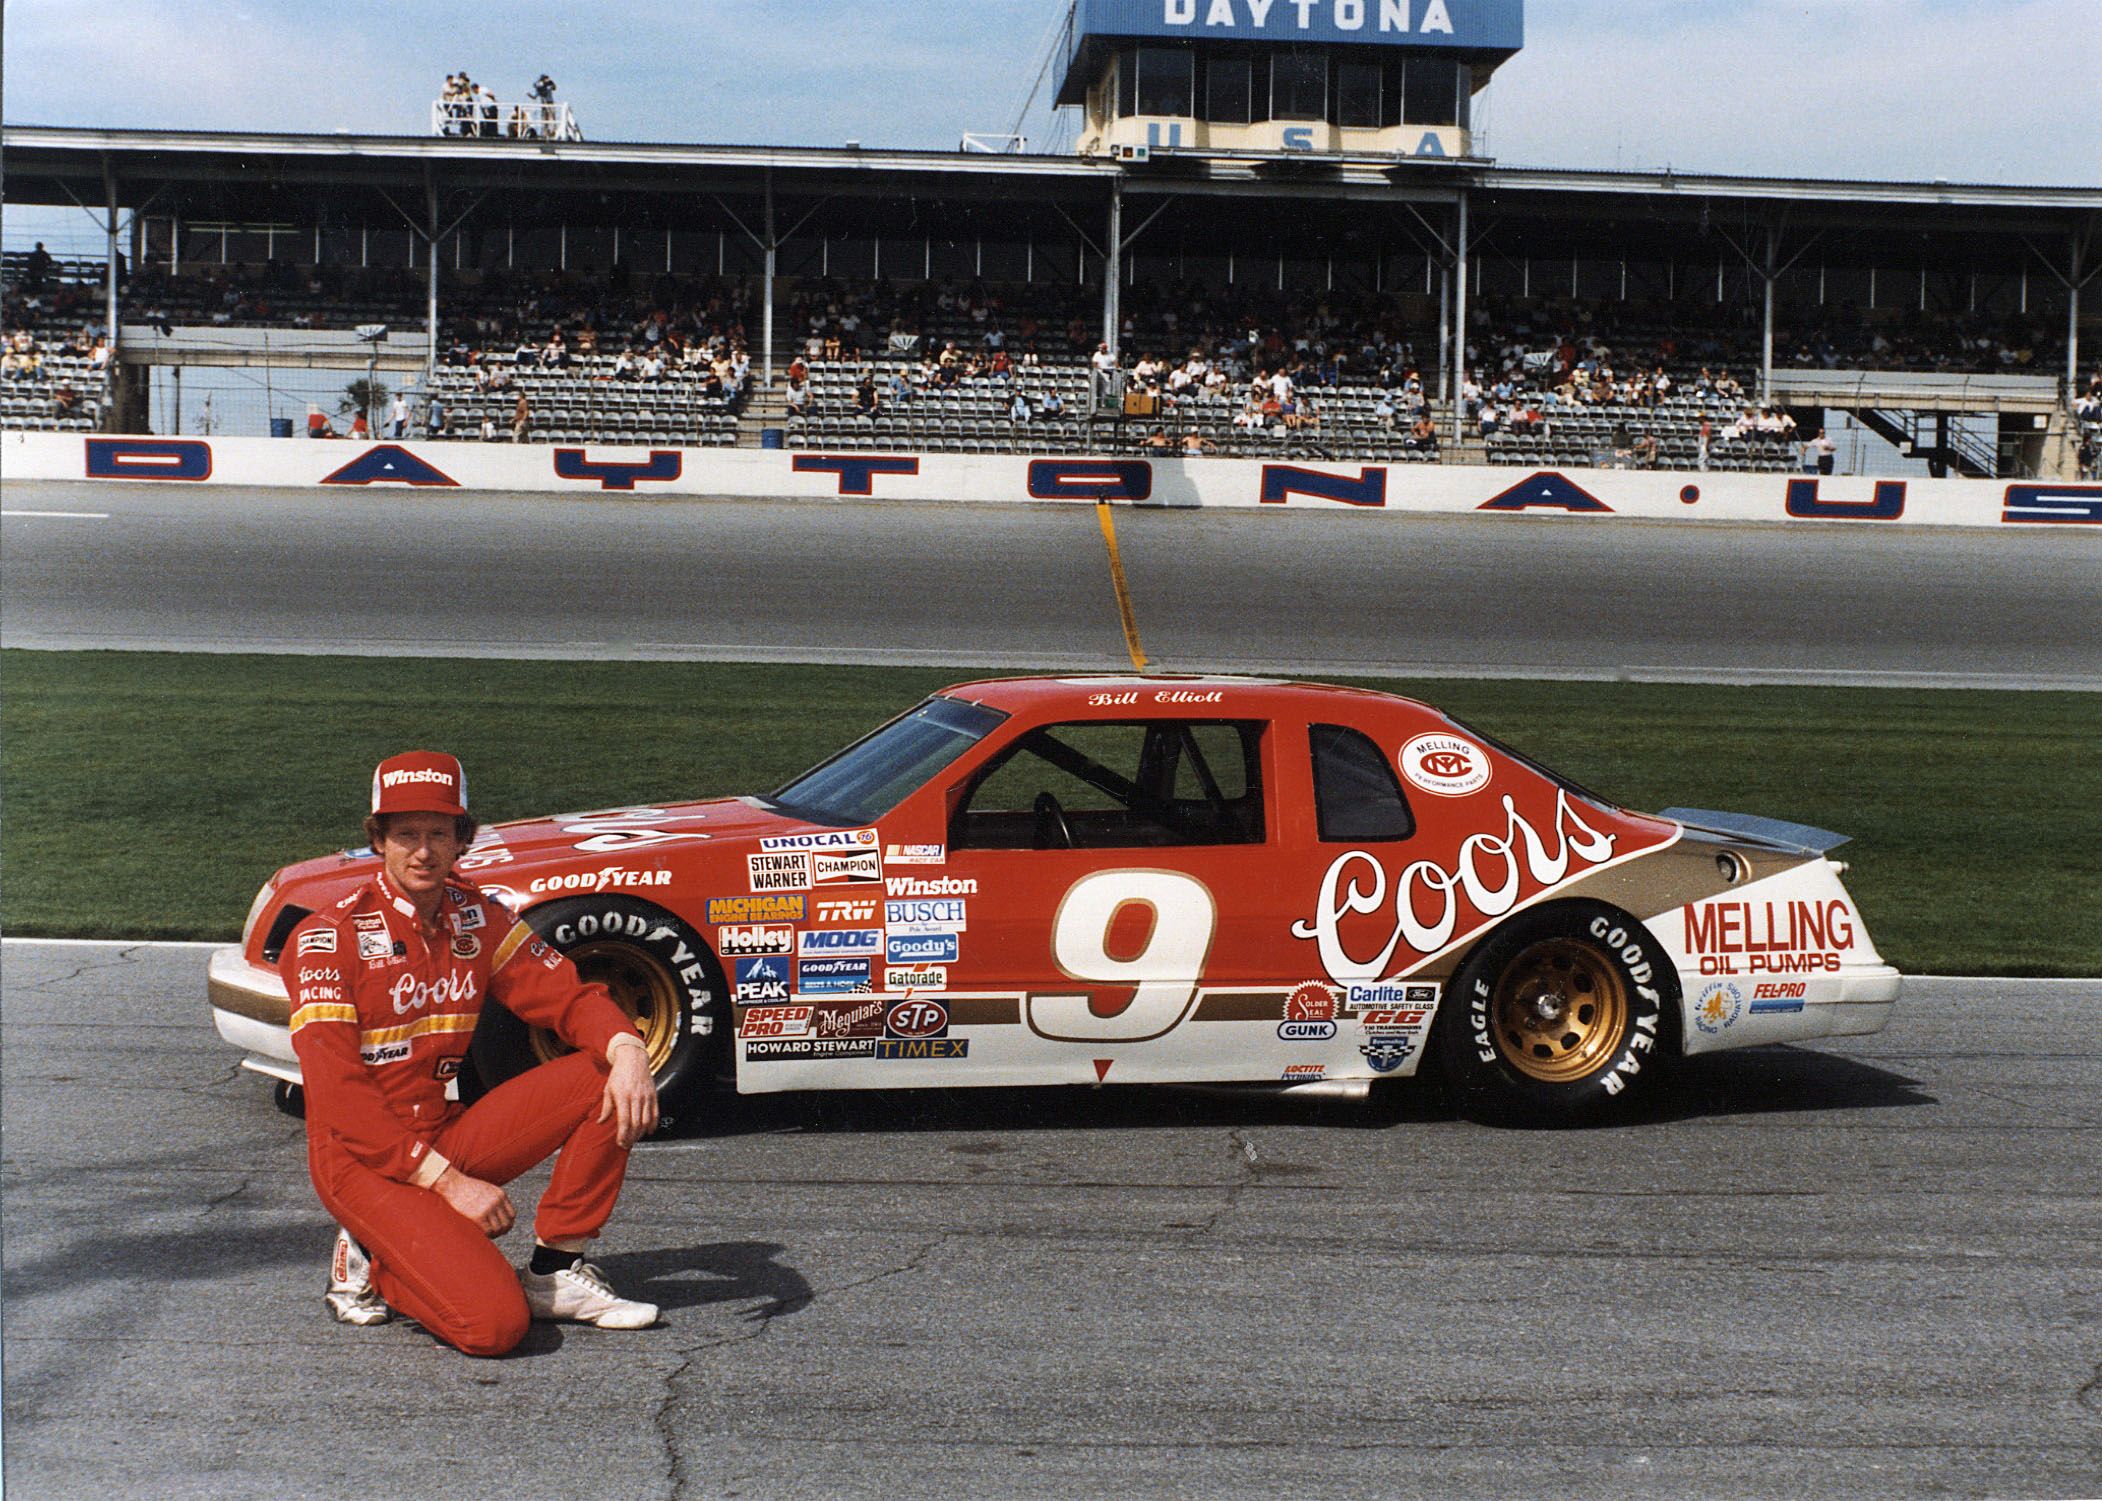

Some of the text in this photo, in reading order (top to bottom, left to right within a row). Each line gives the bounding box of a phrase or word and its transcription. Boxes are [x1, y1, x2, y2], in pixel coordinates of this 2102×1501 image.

[1164, 0, 1455, 34] DAYTONA
[1088, 690, 1223, 705] Bill Elliott
[1416, 741, 1471, 755] MELLING
[383, 768, 453, 788] Winston
[763, 833, 856, 848] UNOCAL
[903, 845, 942, 856] NASCAR
[751, 855, 806, 871] STEWART
[817, 860, 876, 873] CHAMPION
[530, 866, 672, 892] GOODYEAR
[753, 872, 808, 889] WARNER
[885, 876, 977, 896] Winston
[1290, 787, 1618, 989] Coors
[709, 896, 804, 914] MICHIGAN
[816, 900, 877, 921] TRW
[886, 902, 964, 922] BUSCH
[1684, 900, 1854, 954] MELLING
[722, 926, 791, 952] Holley
[803, 931, 878, 948] MOOG
[889, 939, 956, 958] Goody's
[1025, 867, 1218, 1044] 9
[555, 911, 714, 1036] GOODYEAR
[802, 961, 867, 973] GOODYEAR
[1700, 953, 1841, 976] OIL PUMPS
[889, 971, 942, 985] Gatorade
[389, 968, 477, 1015] Coors
[736, 981, 788, 999] PEAK
[1350, 986, 1404, 1001] Carlite
[1753, 982, 1806, 999] FEL-PRO
[747, 1008, 809, 1022] SPEED
[1590, 916, 1661, 1096] GOODYEAR
[895, 1004, 939, 1030] STP
[1471, 979, 1497, 1063] EAGLE
[743, 1022, 784, 1035] PRO
[1286, 1025, 1328, 1036] GUNK
[747, 1040, 874, 1054] HOWARD STEWART
[879, 1040, 965, 1058] TIMEX
[1284, 1065, 1325, 1073] LOCTITE
